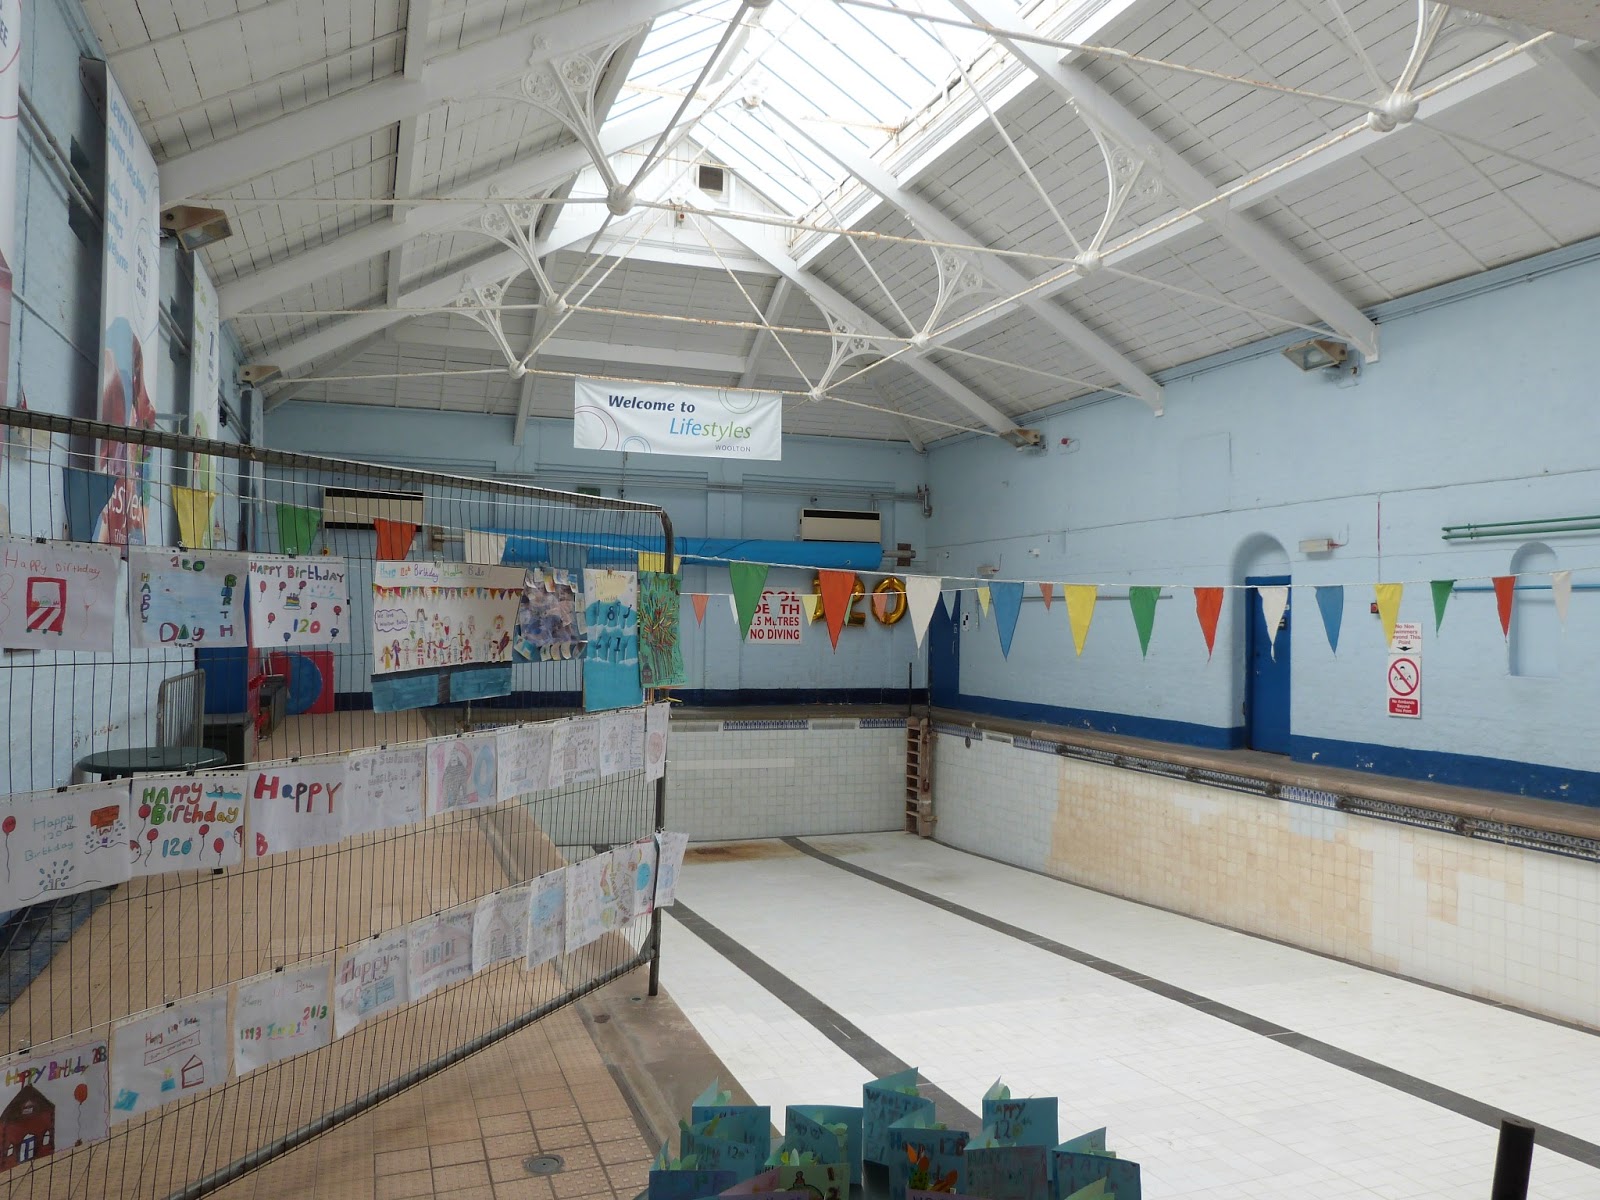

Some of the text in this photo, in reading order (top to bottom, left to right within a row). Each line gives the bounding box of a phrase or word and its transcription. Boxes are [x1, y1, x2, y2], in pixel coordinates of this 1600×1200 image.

[608, 394, 695, 413] Welcome to
[669, 417, 752, 442] Lifestyles
[715, 444, 751, 452] WOOLTON
[5, 548, 47, 575] Happy
[755, 603, 800, 615] DETH
[293, 618, 321, 634] 120
[750, 628, 800, 640] NO DIVING
[151, 801, 239, 826] Birthday
[32, 814, 74, 832] Happy
[24, 841, 74, 862] Birthday
[341, 955, 390, 985] Happy
[303, 1004, 327, 1020] 2013
[240, 1027, 262, 1041] 1893
